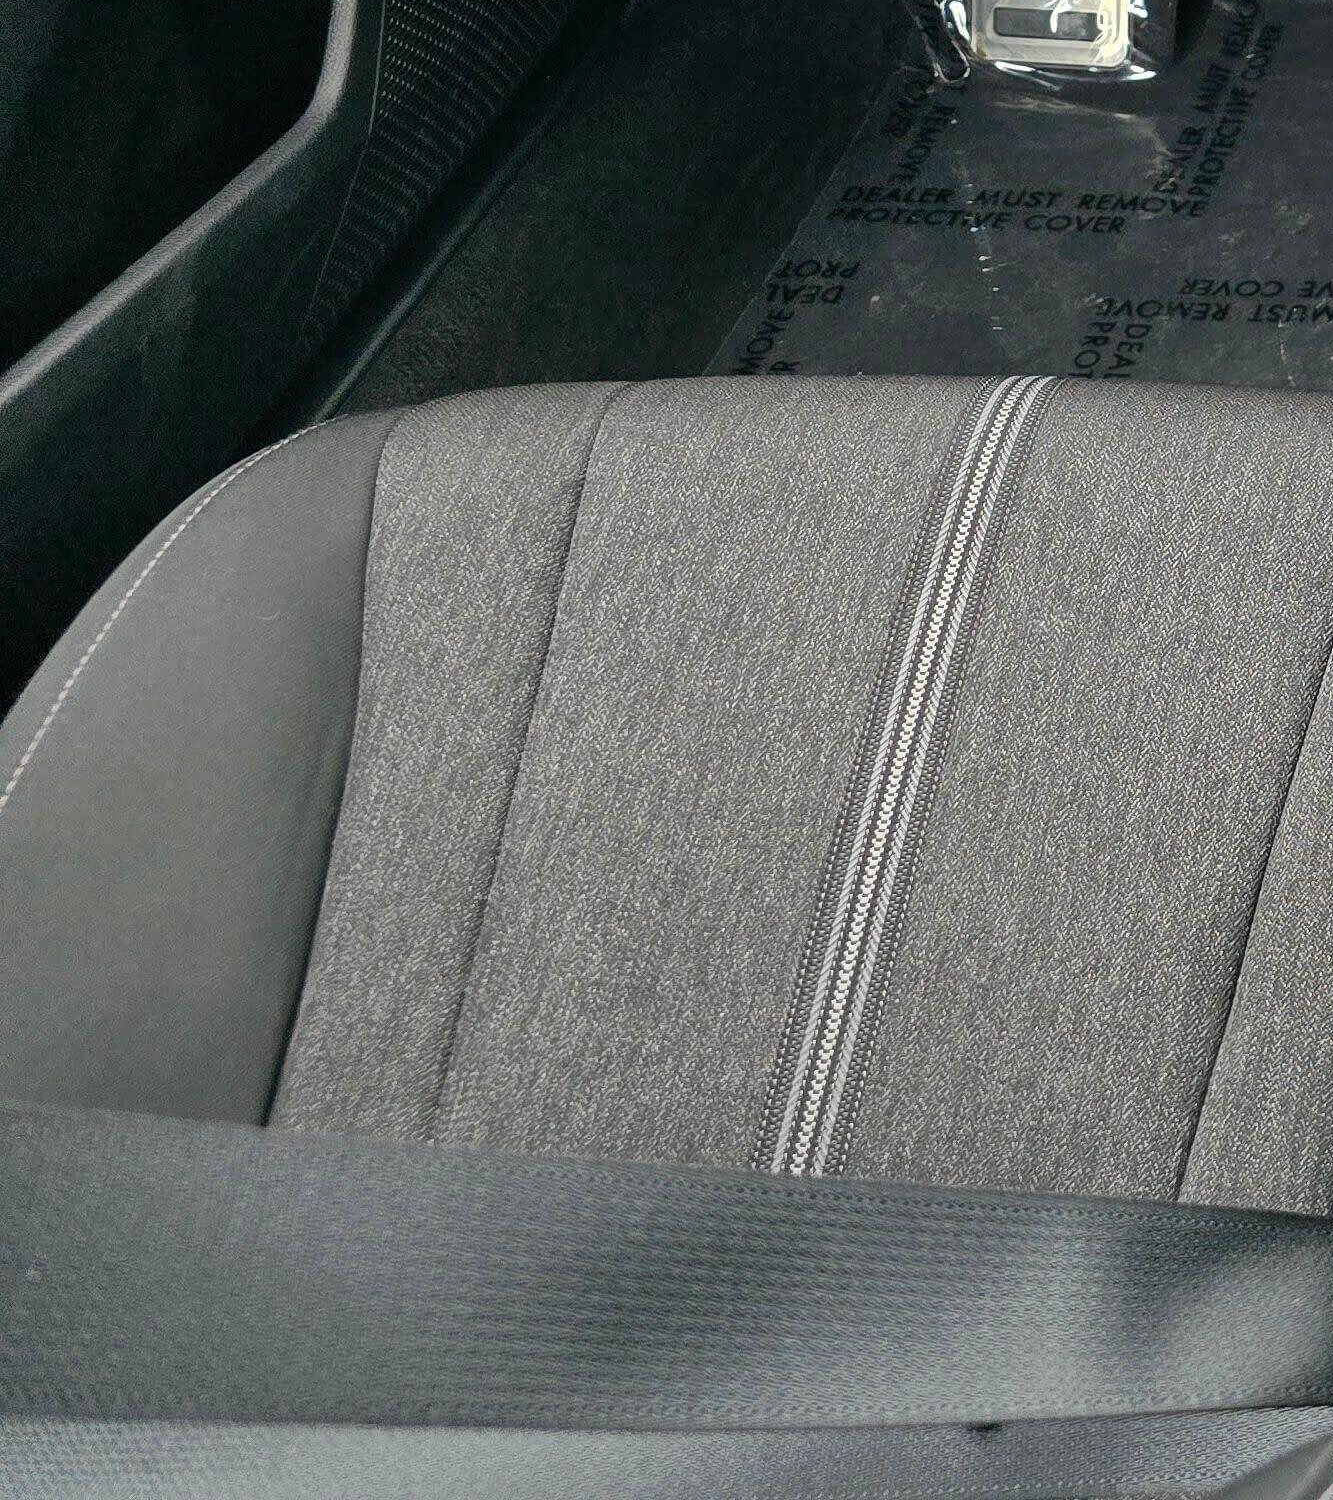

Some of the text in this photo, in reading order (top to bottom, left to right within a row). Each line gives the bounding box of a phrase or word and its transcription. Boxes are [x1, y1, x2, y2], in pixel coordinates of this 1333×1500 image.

[841, 185, 1209, 218] DEALER MUST REMOVE
[826, 207, 1127, 235] PROTECTIVE COVER
[1180, 278, 1285, 299] COVER
[1095, 297, 1231, 323] REMOVE
